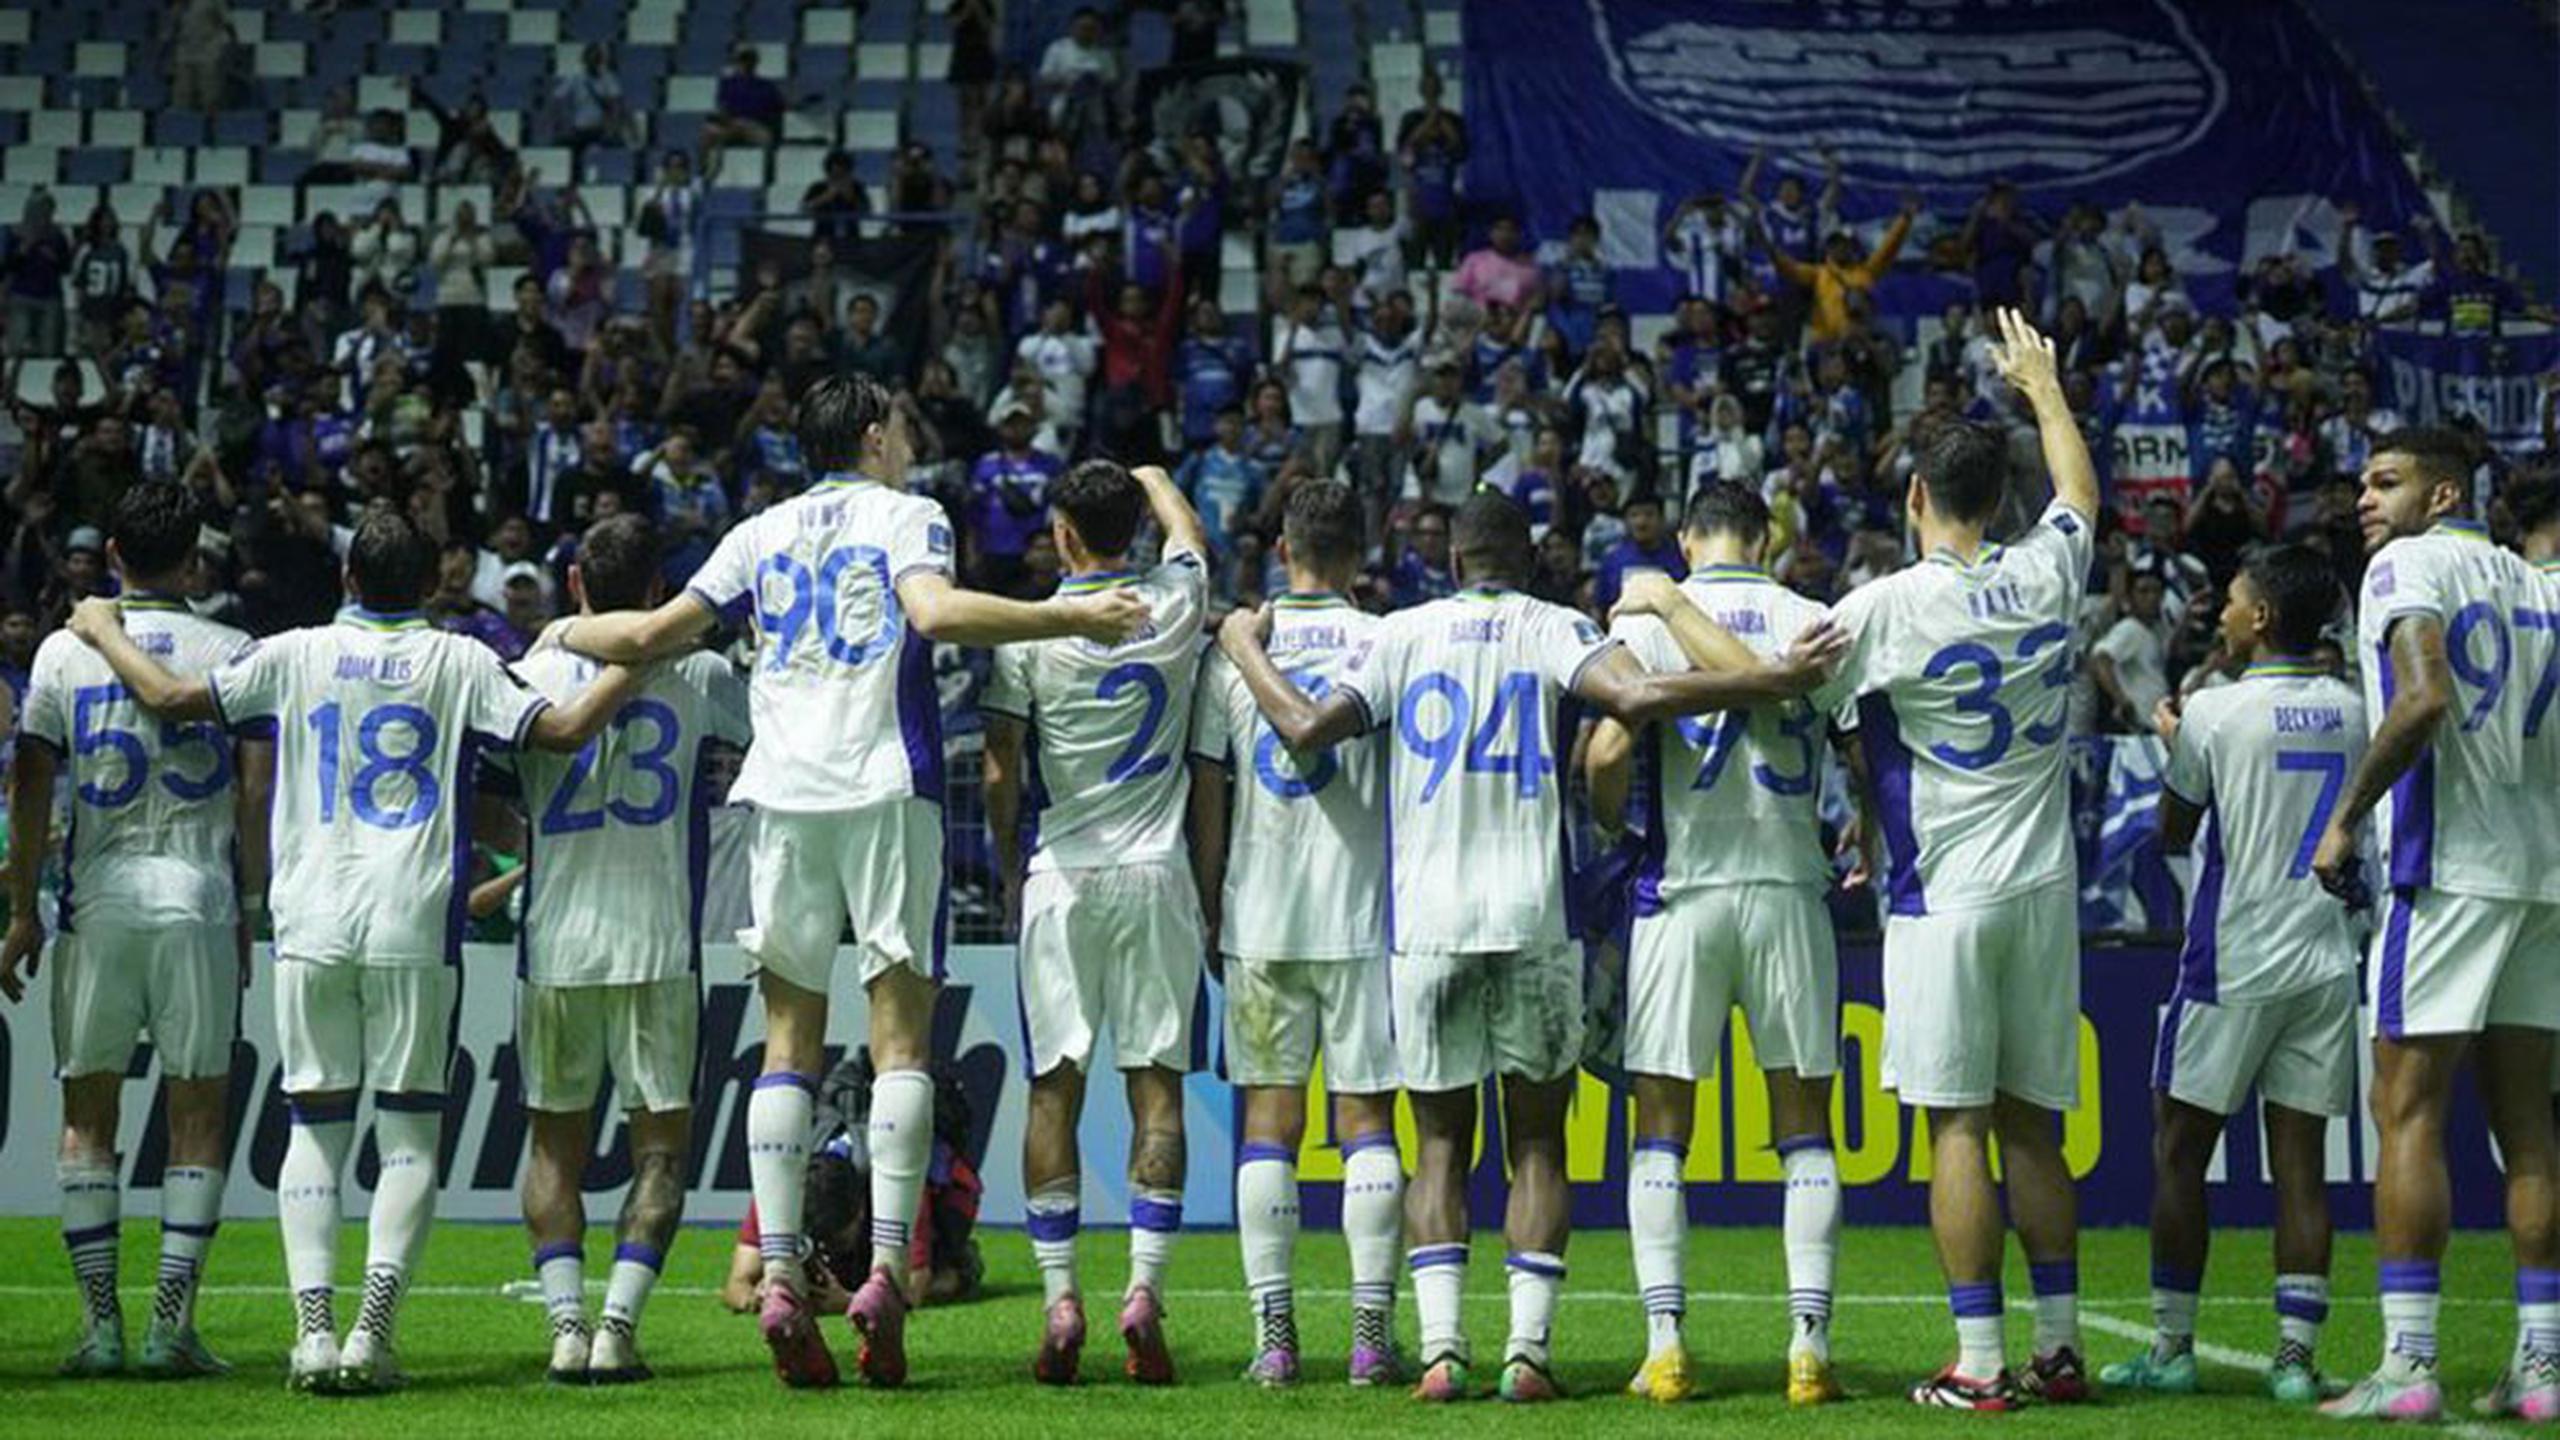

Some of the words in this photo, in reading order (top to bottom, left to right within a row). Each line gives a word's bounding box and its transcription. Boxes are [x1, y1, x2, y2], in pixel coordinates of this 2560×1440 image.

[755, 544, 903, 672] 90
[74, 681, 234, 808] 55
[1096, 663, 1170, 783] 2
[1399, 671, 1554, 804] 94
[1923, 621, 2074, 770] 33
[2274, 705, 2343, 732] BECKHAM
[309, 701, 440, 830] 18
[541, 697, 680, 836] 23
[2276, 752, 2345, 880] 7
